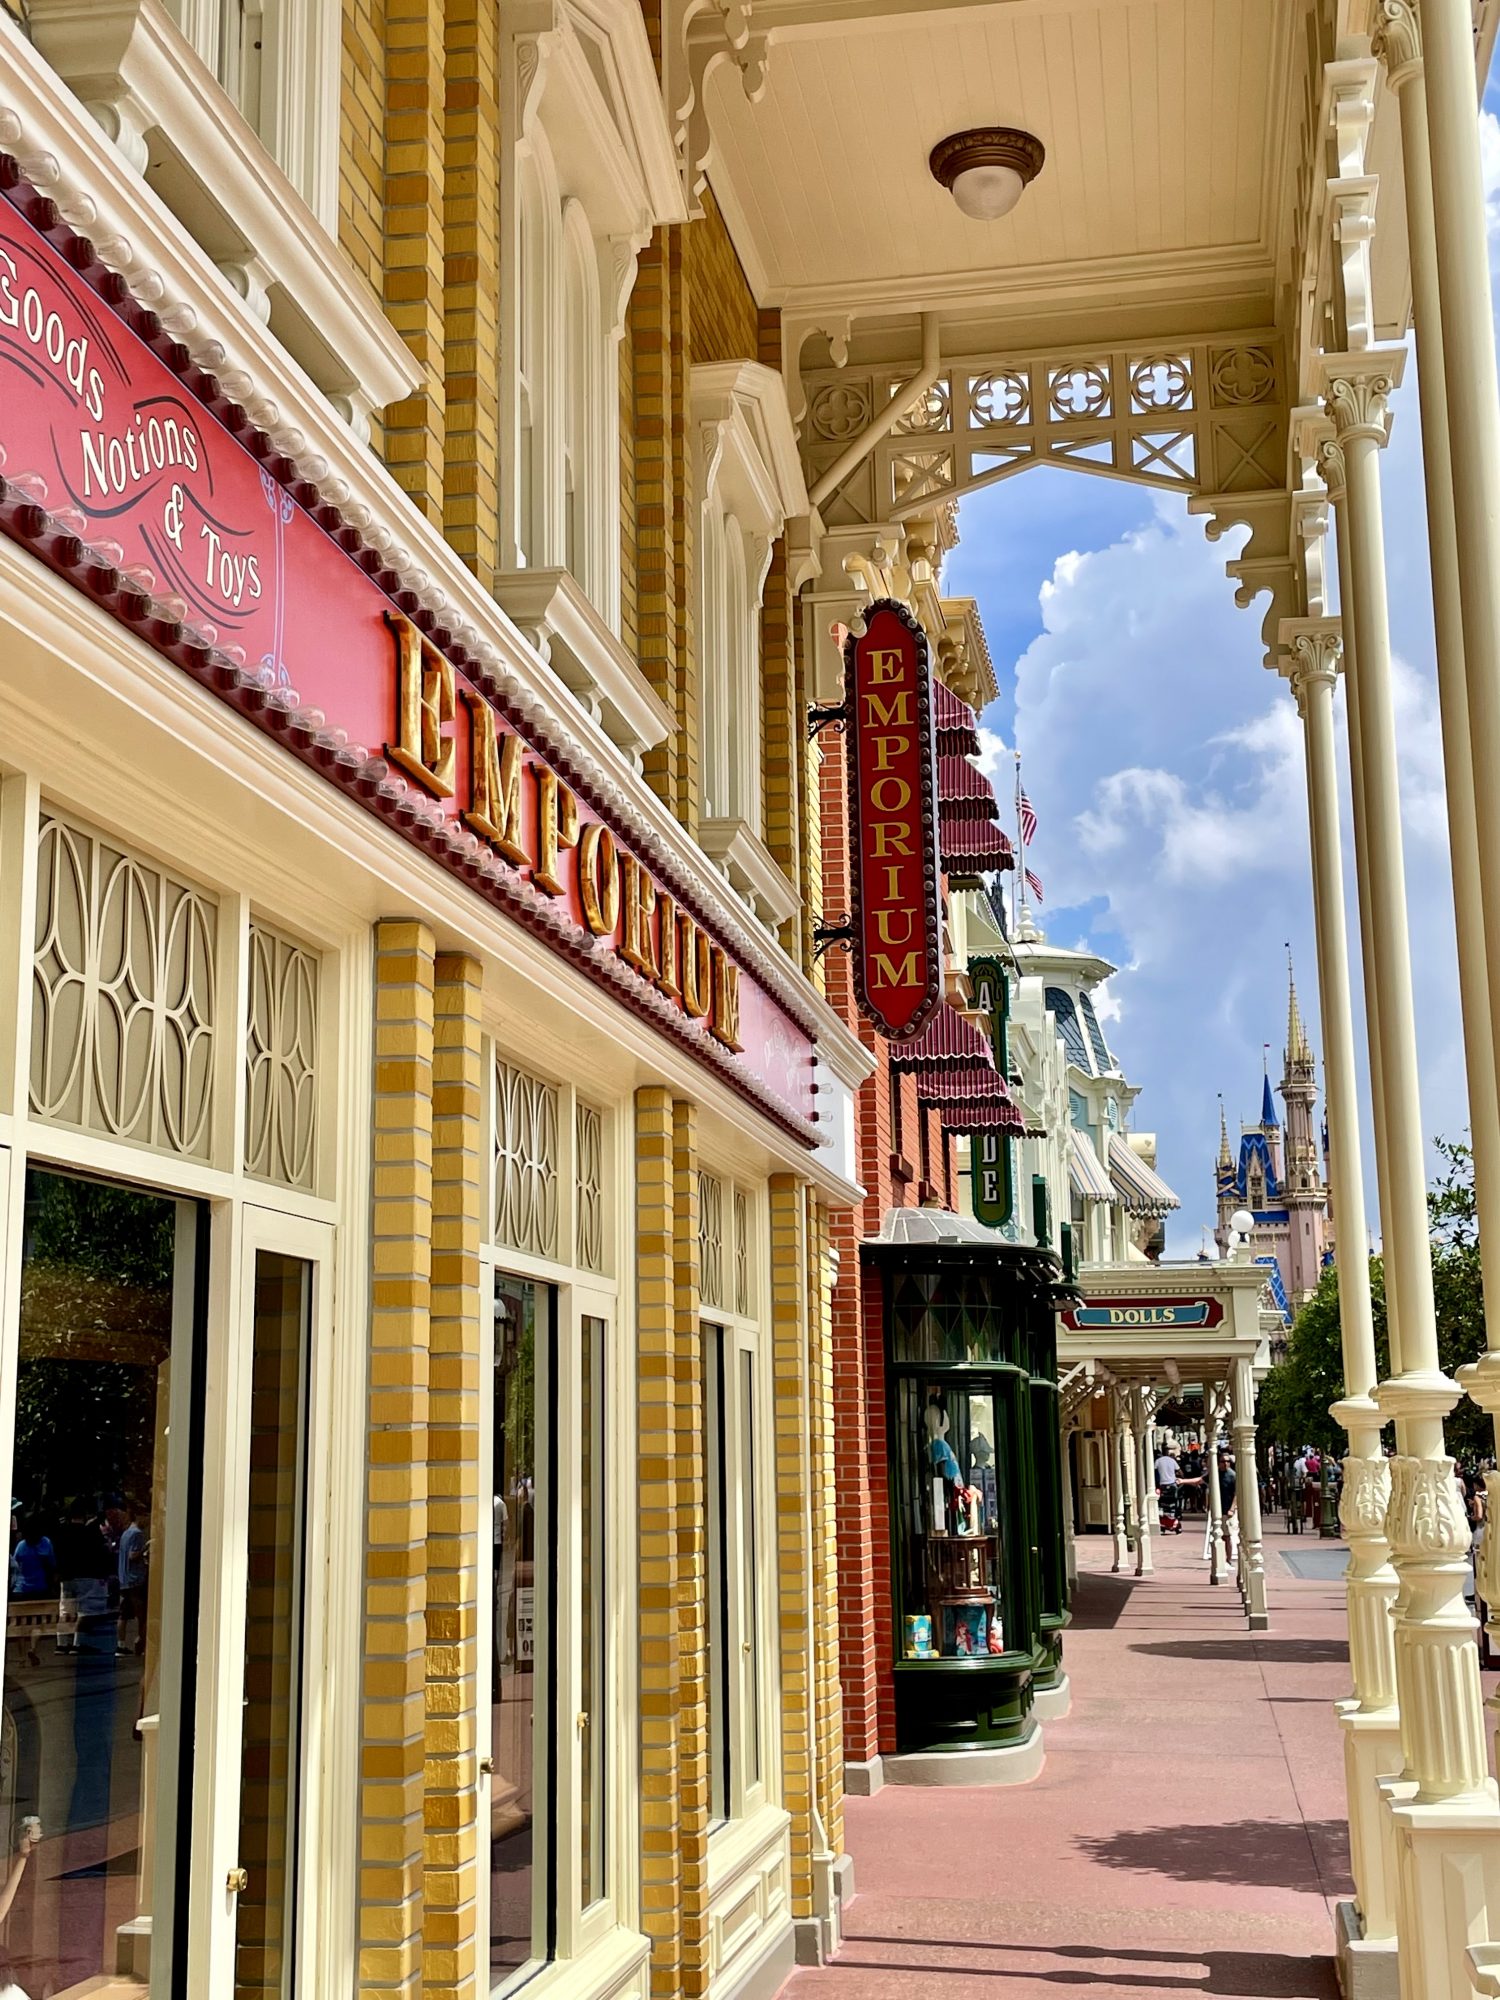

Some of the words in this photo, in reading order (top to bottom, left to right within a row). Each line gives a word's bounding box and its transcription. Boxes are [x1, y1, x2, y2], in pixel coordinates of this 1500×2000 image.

[81, 412, 197, 496] Notions
[164, 484, 186, 552] &
[201, 525, 262, 606] Toys
[385, 611, 744, 1052] EMPORIUM
[862, 648, 924, 989] EMPORIUM
[1109, 1308, 1176, 1324] DOLLS
